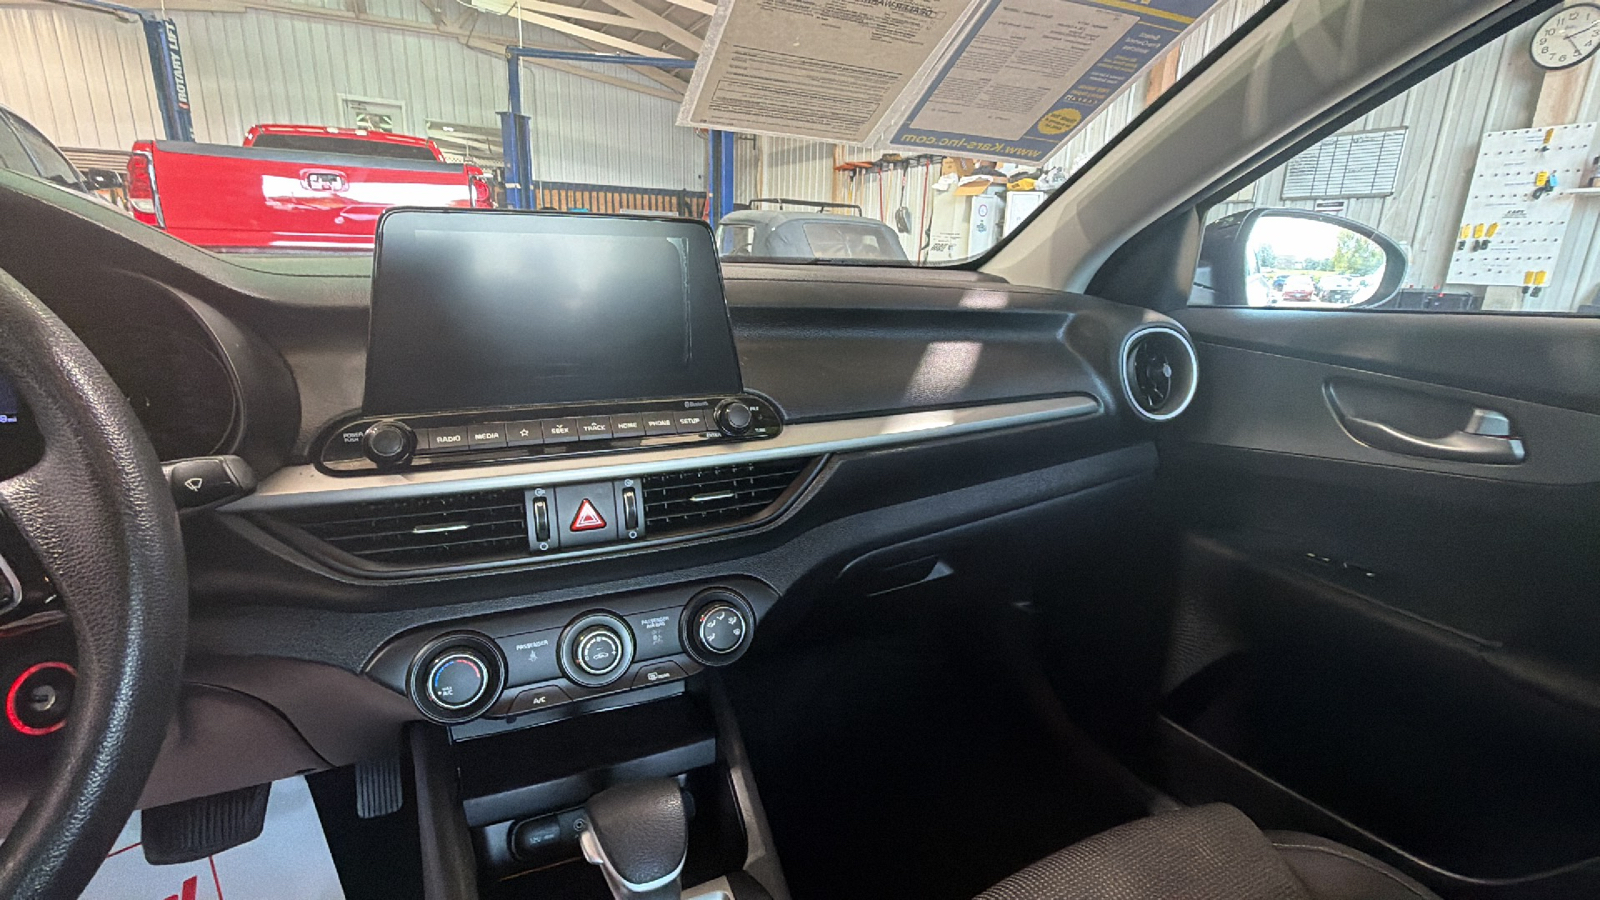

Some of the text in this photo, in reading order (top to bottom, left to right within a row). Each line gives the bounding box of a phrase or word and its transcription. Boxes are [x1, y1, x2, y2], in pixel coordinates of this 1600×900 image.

[1569, 12, 1579, 21] 12
[1557, 18, 1566, 27] 11
[1545, 29, 1556, 37] 10
[1539, 38, 1547, 46] 9
[1549, 53, 1557, 61] 7
[165, 20, 188, 103] ROTARY LIFT
[647, 419, 670, 427] PHONE
[680, 417, 700, 425] SETUP
[583, 424, 606, 432] TRACK
[436, 434, 461, 443] RADIO
[474, 432, 499, 441] MEDIA
[641, 616, 669, 626] PASSENGER
[516, 639, 549, 651] PASSENGER
[533, 696, 546, 704] A/C
